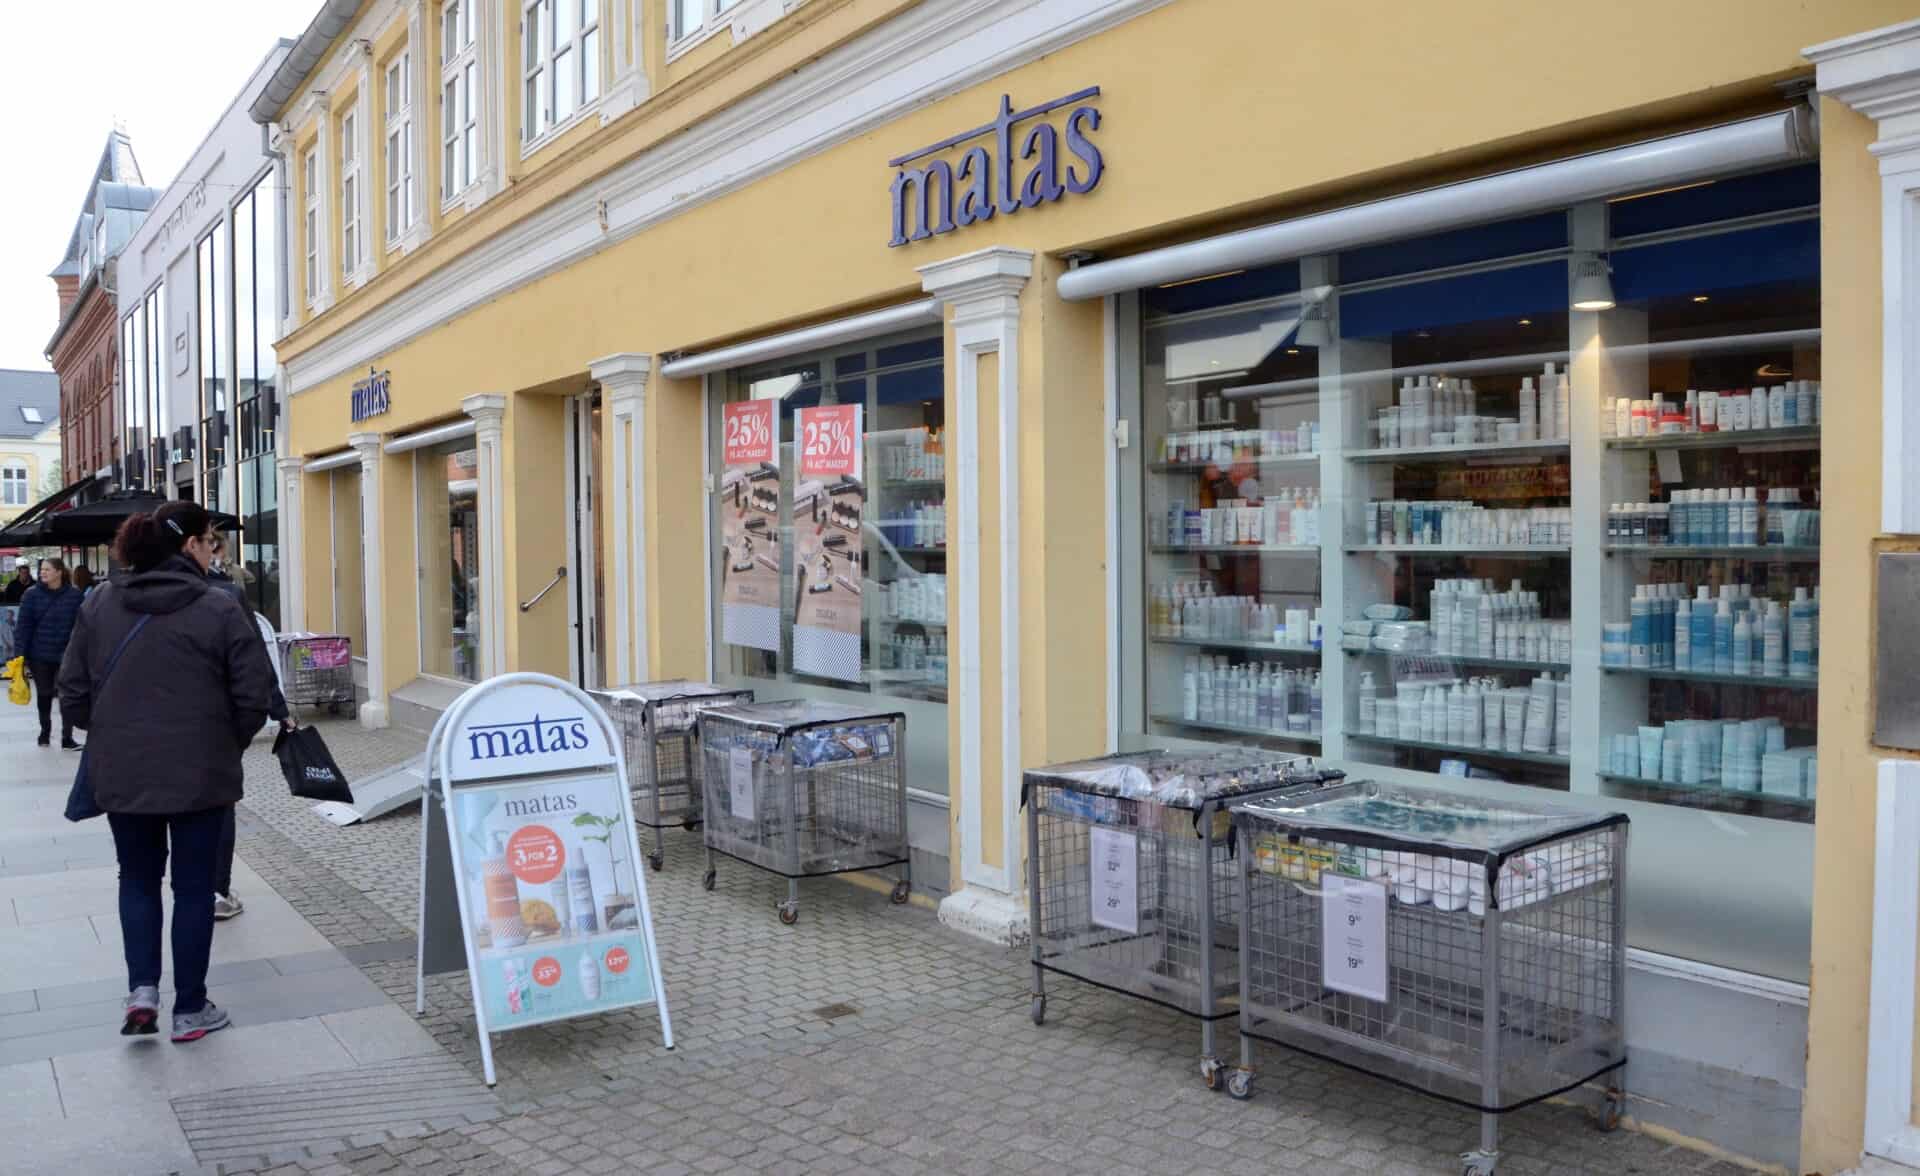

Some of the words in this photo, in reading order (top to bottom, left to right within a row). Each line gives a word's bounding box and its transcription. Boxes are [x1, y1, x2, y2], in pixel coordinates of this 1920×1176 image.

[888, 86, 1104, 248] matas
[352, 366, 391, 423] matas
[728, 411, 769, 447] 25%
[804, 419, 851, 456] 25%
[467, 713, 590, 760] matas
[504, 793, 578, 817] matas
[514, 849, 527, 866] 3
[545, 845, 558, 863] 2
